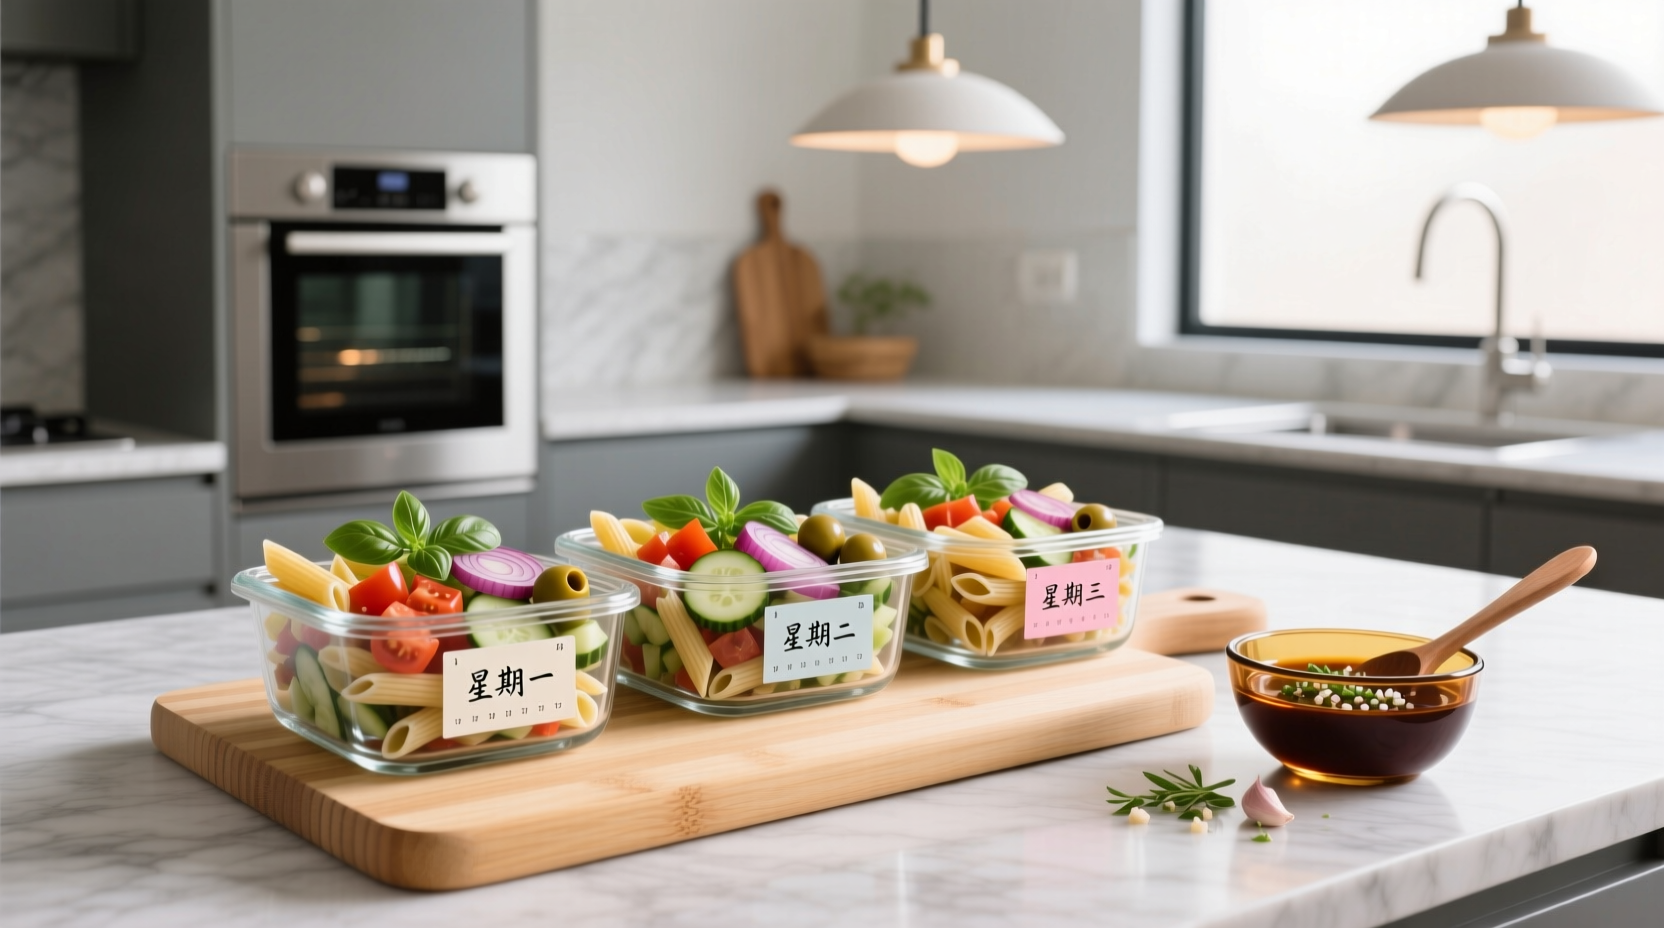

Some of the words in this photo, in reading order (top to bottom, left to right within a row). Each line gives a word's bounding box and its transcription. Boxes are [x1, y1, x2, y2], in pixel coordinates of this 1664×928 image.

[1042, 581, 1106, 611] 星期三
[783, 620, 856, 653] 星期二
[468, 665, 554, 703] 星期一
